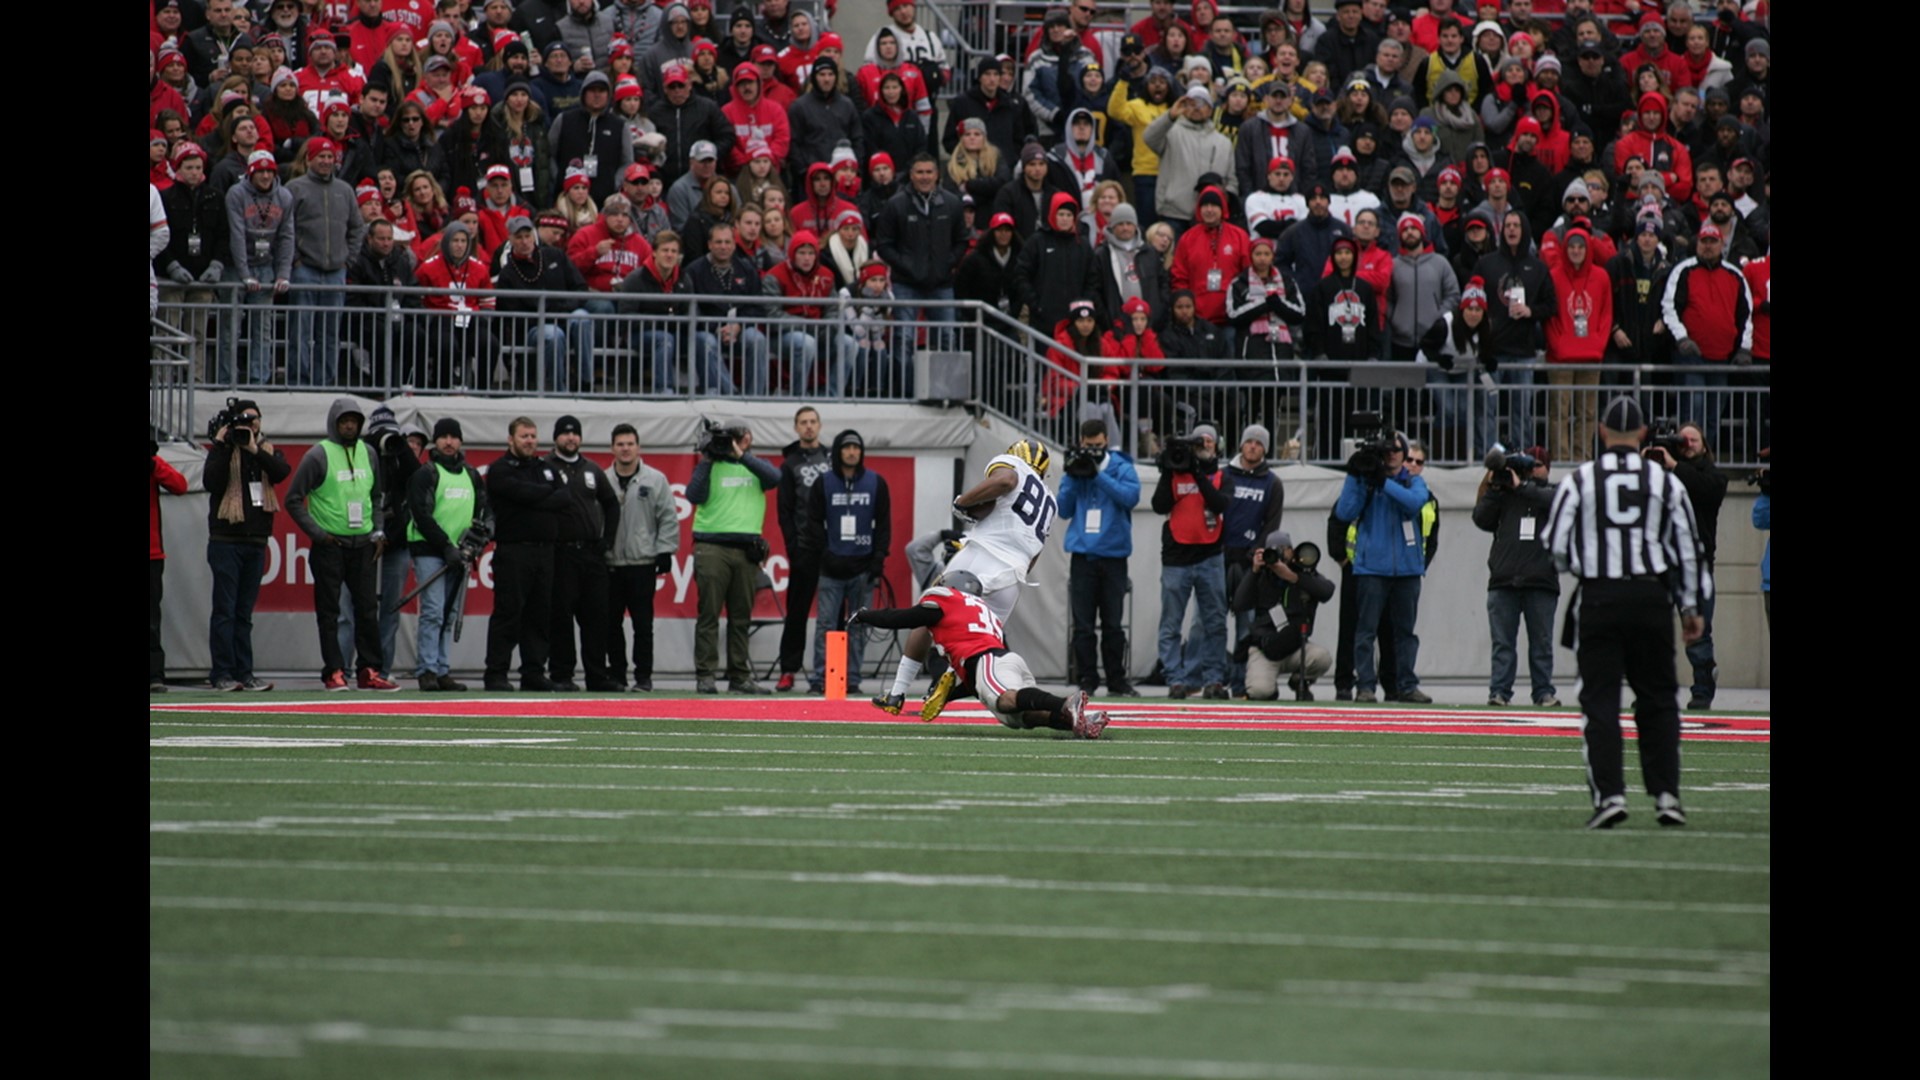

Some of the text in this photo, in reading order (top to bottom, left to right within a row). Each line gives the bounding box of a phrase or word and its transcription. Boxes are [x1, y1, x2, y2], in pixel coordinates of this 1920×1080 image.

[831, 493, 871, 506] ESPN
[1011, 473, 1059, 545] 80
[1234, 486, 1265, 502] SPN
[1605, 473, 1641, 524] C
